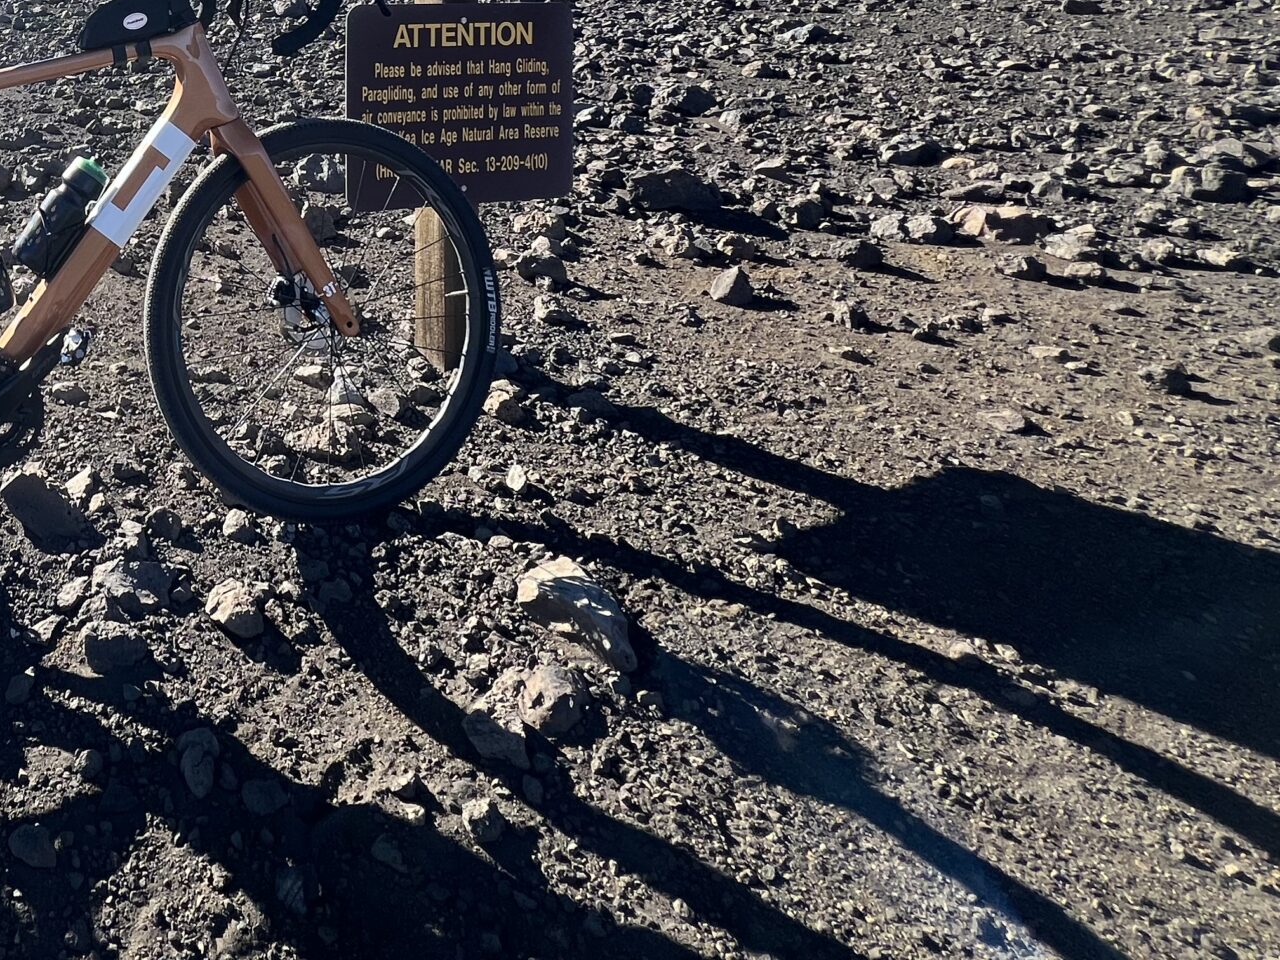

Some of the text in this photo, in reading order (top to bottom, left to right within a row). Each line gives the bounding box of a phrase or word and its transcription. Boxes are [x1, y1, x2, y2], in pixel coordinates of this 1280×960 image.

[393, 21, 533, 48] ATTENTION
[374, 58, 550, 78] Please be advised that Hang Gliding,
[362, 79, 561, 105] Paragliding, and use of any other form of
[361, 101, 562, 126] air conveyance is prohibited by law within the
[421, 129, 435, 144] Ice
[440, 128, 458, 146] Age
[462, 126, 494, 141] Natural
[499, 125, 520, 140] Area
[524, 124, 560, 138] Reserve
[459, 158, 480, 174] Sec.
[486, 153, 548, 172] 13-209-4(10)
[484, 276, 497, 313] WTB
